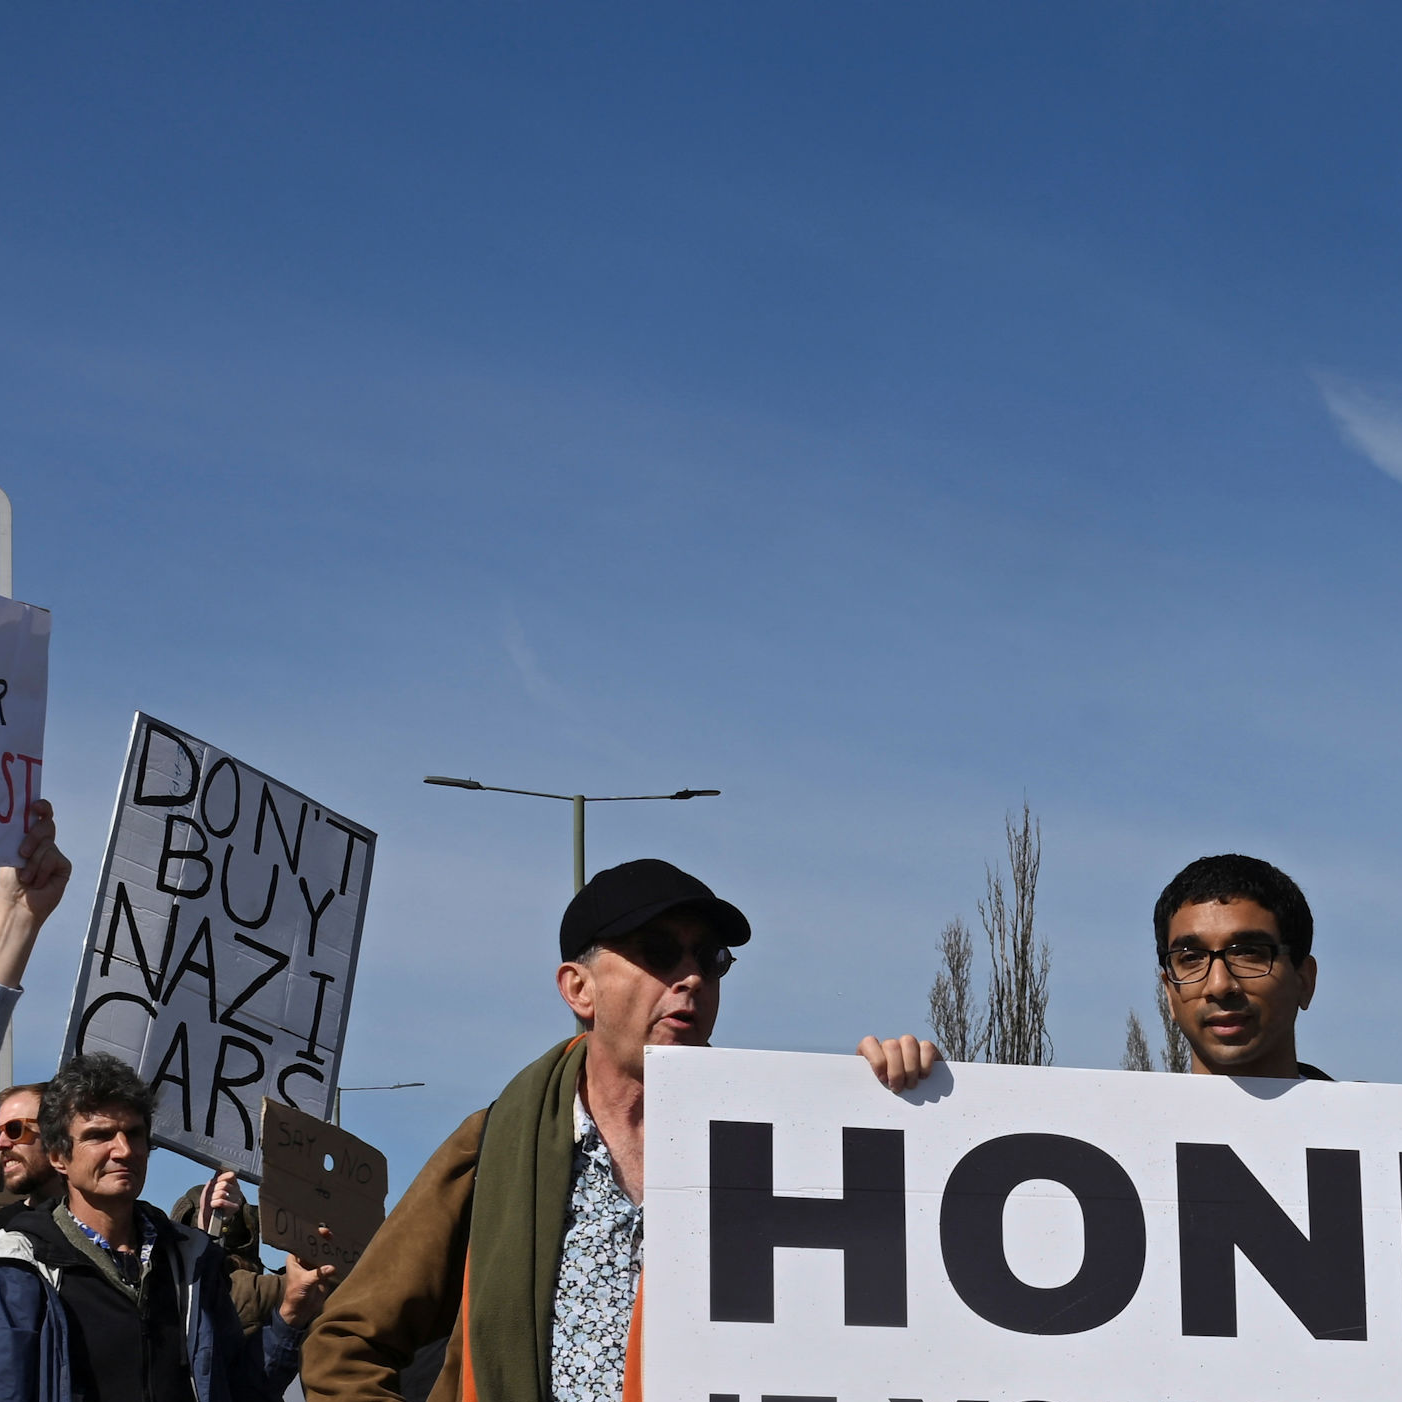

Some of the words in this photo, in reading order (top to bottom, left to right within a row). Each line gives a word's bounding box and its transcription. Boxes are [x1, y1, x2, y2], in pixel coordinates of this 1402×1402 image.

[132, 722, 370, 896] DON'T
[156, 814, 336, 957] BUY
[100, 881, 336, 1066] NAZI
[339, 1147, 373, 1184] NO
